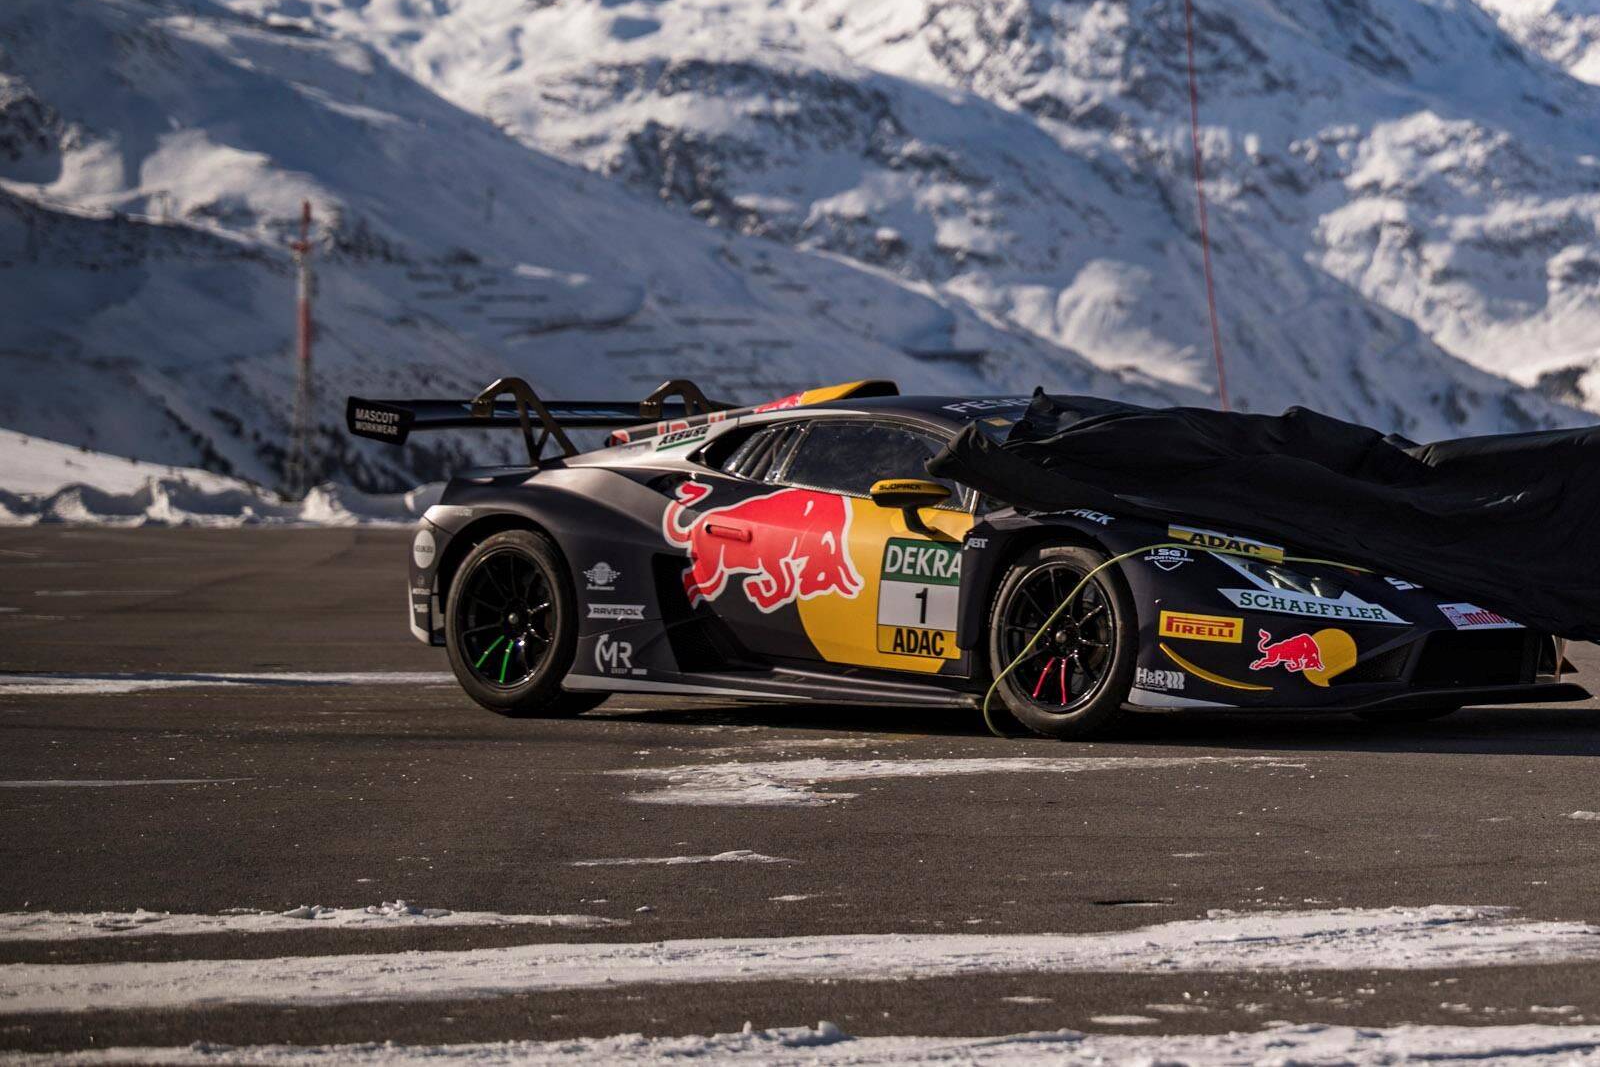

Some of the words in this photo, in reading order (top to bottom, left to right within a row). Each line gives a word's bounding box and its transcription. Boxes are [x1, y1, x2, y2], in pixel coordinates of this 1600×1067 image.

[355, 408, 400, 424] MASCOT
[1188, 533, 1260, 554] ADAC
[884, 545, 962, 578] DEKRA
[915, 587, 929, 624] 1
[1239, 592, 1388, 621] SCHAEFFLER
[1165, 616, 1236, 638] PIRELLI
[601, 641, 632, 668] MR
[893, 627, 945, 656] ADAC
[1136, 667, 1166, 685] H&R
